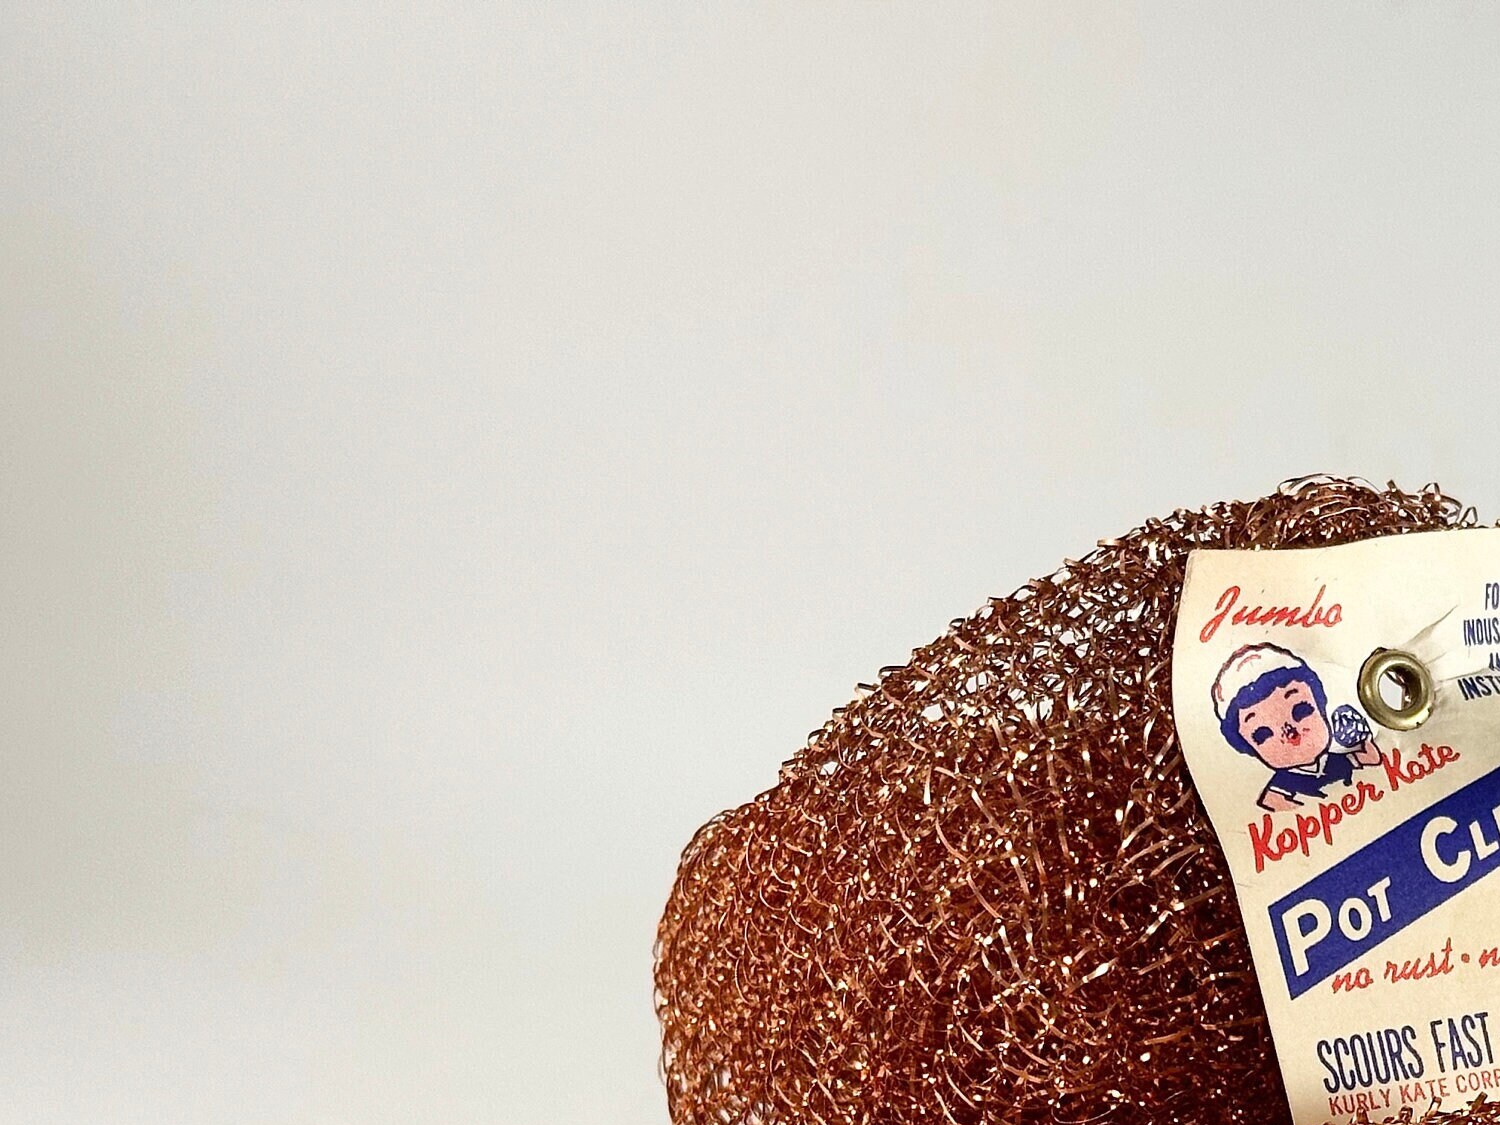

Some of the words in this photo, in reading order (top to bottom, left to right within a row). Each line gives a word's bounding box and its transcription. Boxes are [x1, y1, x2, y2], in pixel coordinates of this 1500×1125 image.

[1199, 585, 1343, 642] Jumbo
[1249, 782, 1384, 872] Kopper
[1383, 741, 1460, 792] Kate
[1281, 876, 1392, 977] POT
[1331, 967, 1373, 995] no
[1384, 938, 1454, 983] rust
[1317, 1026, 1424, 1094] SCOURS
[1431, 1012, 1495, 1073] FAST
[1329, 1088, 1390, 1116] KURLY
[1399, 1078, 1450, 1103] KATE
